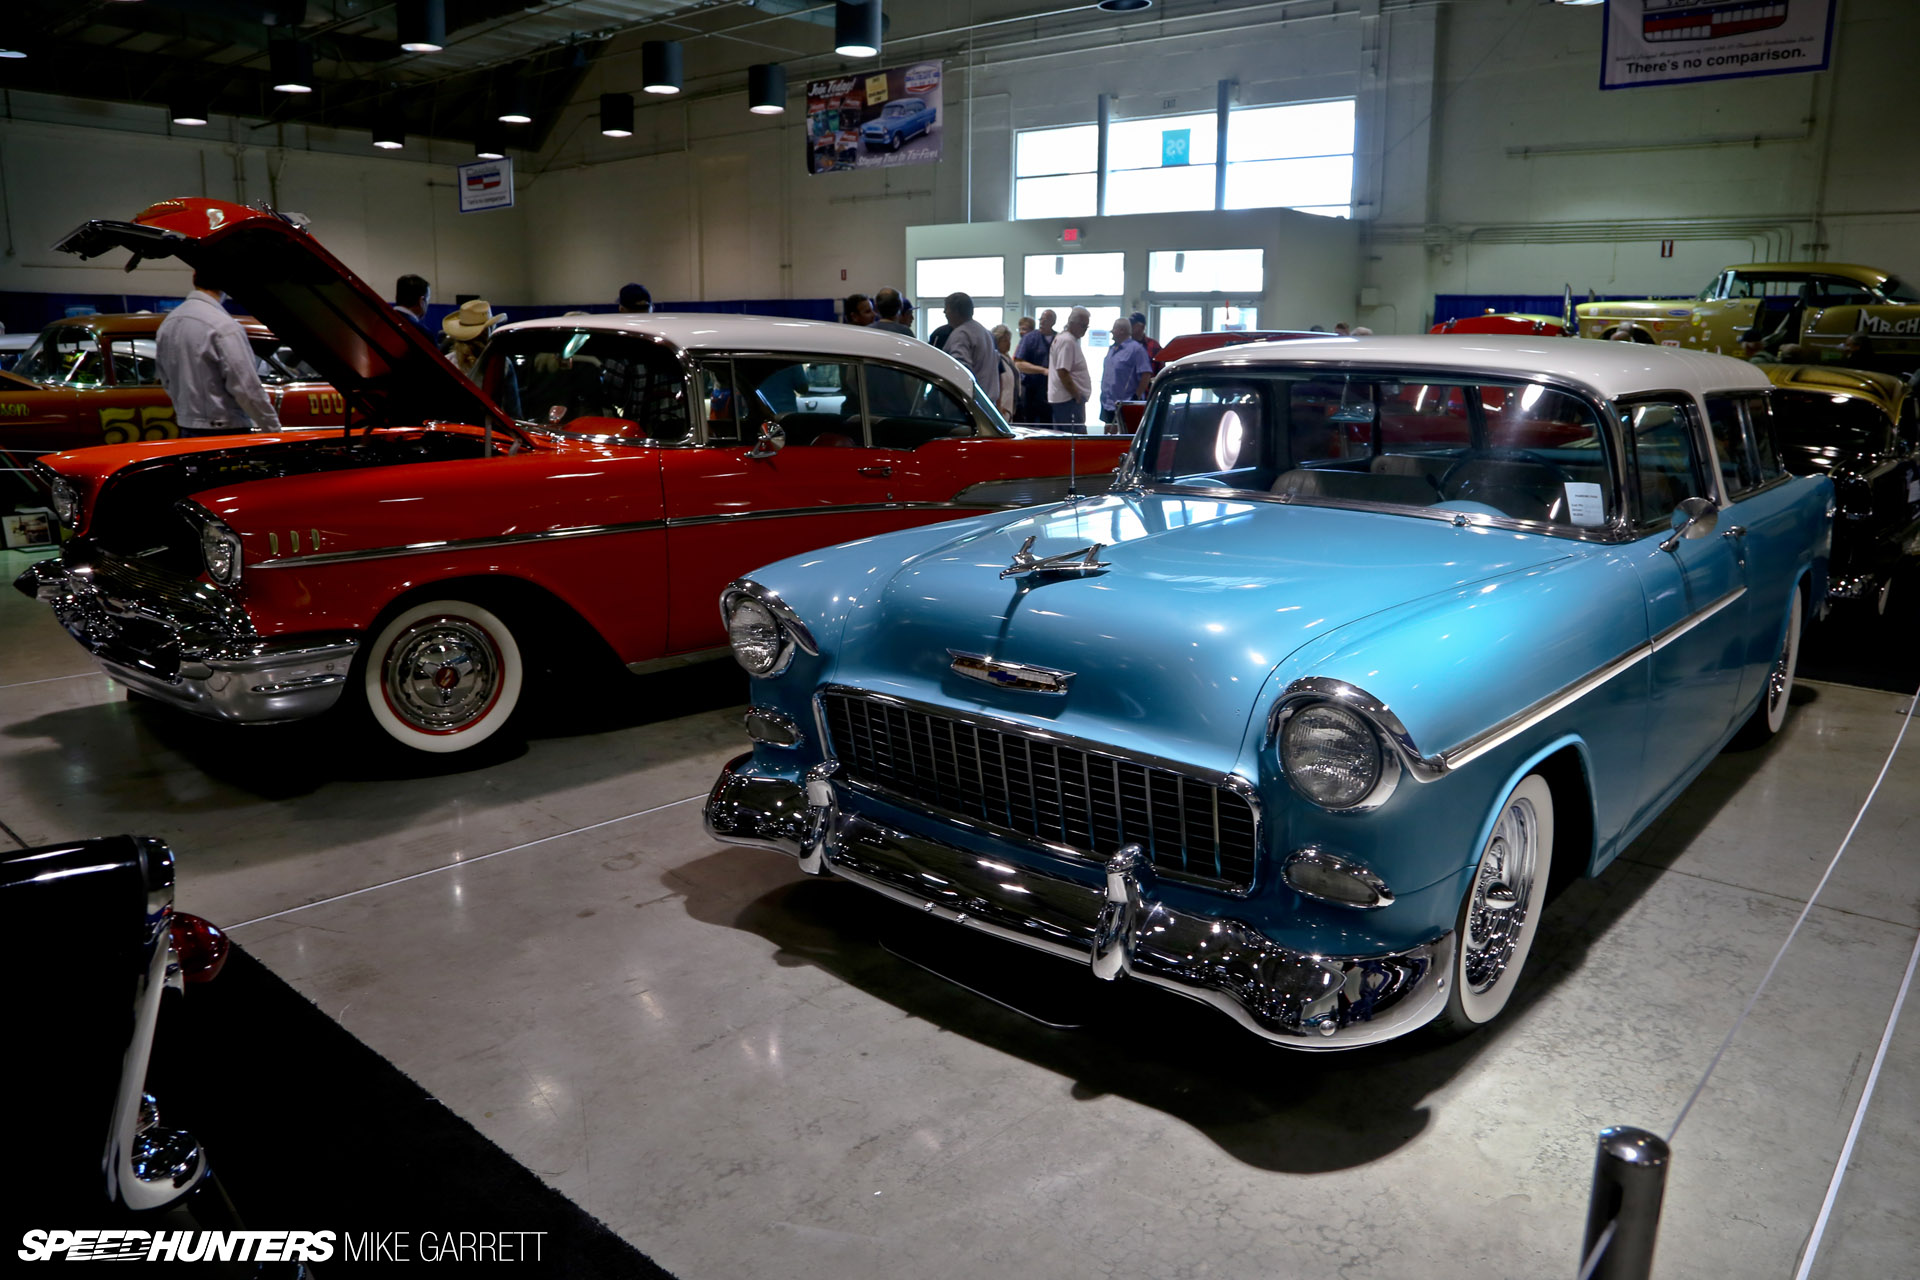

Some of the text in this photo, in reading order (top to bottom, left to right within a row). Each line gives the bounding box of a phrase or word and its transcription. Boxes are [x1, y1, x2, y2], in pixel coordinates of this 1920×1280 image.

[1626, 60, 1679, 75] There's
[1683, 58, 1702, 71] no
[1706, 48, 1807, 67] comparison.
[308, 393, 357, 415] DOU
[98, 407, 179, 445] 55
